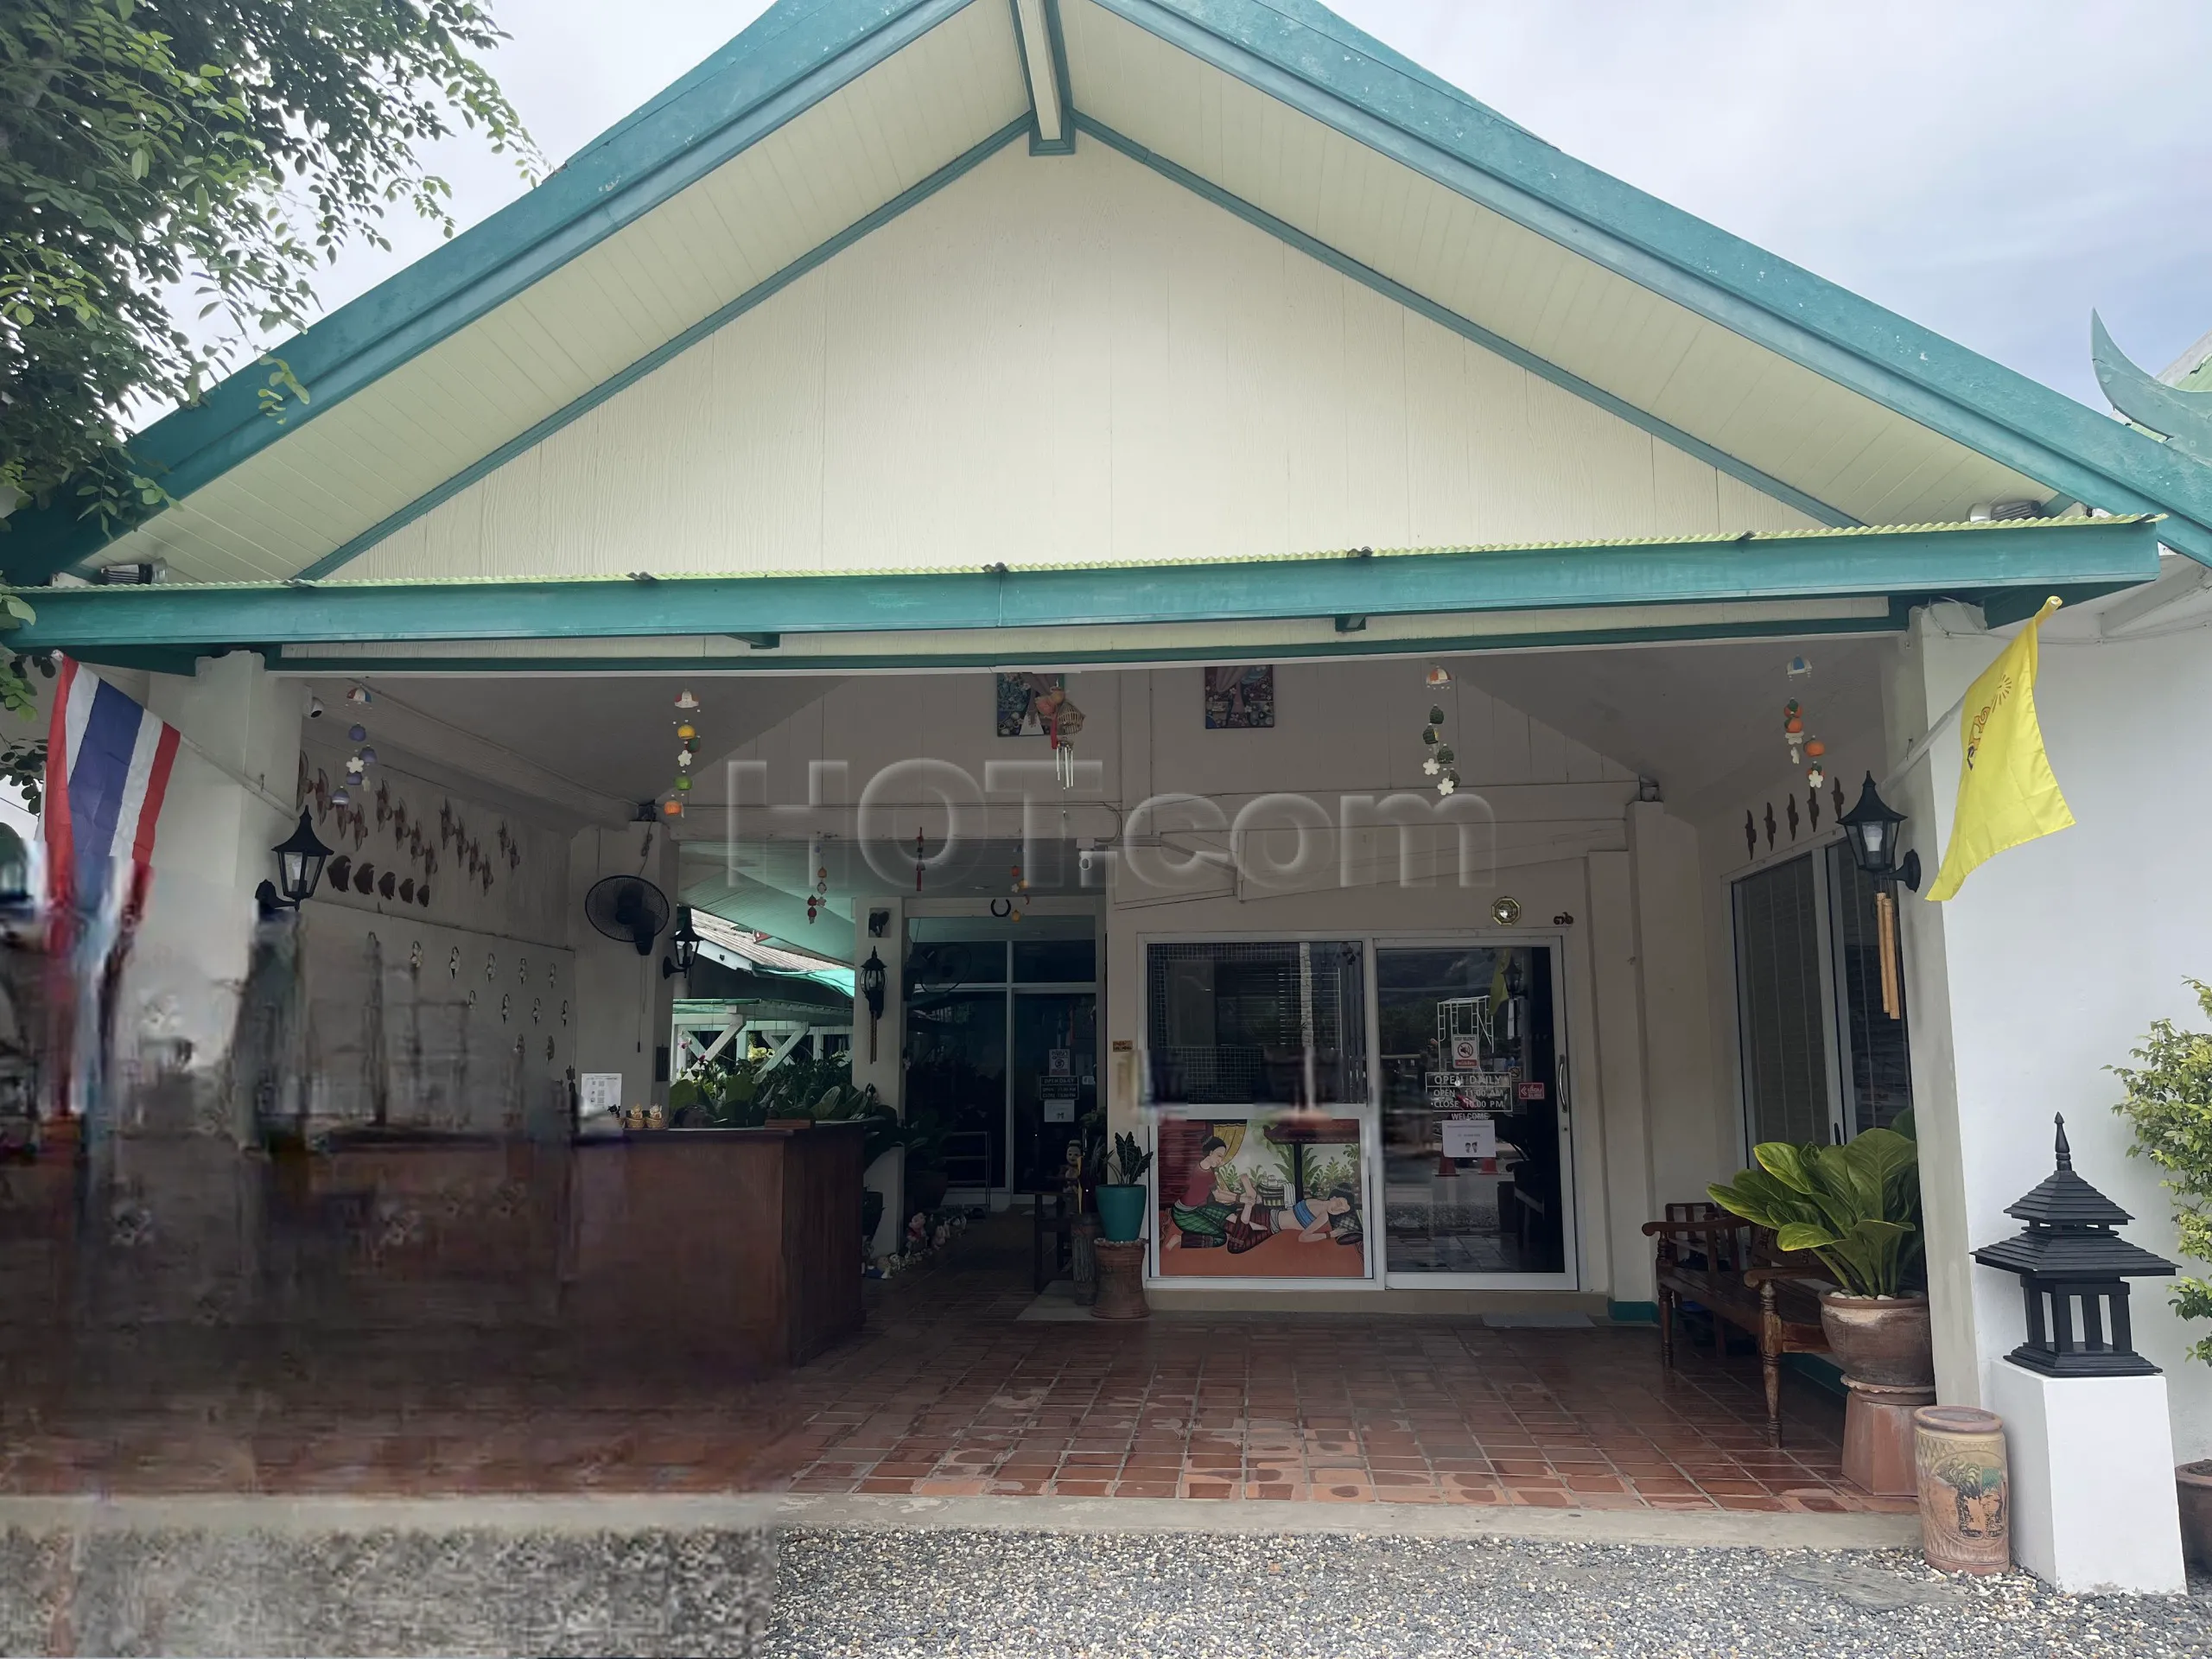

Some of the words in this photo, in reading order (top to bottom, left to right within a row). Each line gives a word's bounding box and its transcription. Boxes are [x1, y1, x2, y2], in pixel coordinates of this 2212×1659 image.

[1433, 1075, 1464, 1085] OPEN
[1469, 1075, 1502, 1085] DAILY
[1433, 1089, 1456, 1097] OPEN
[1489, 1089, 1504, 1097] AM
[1433, 1100, 1459, 1109] CLOSE
[1490, 1100, 1504, 1109] PM
[1451, 1112, 1491, 1121] WELCOME
